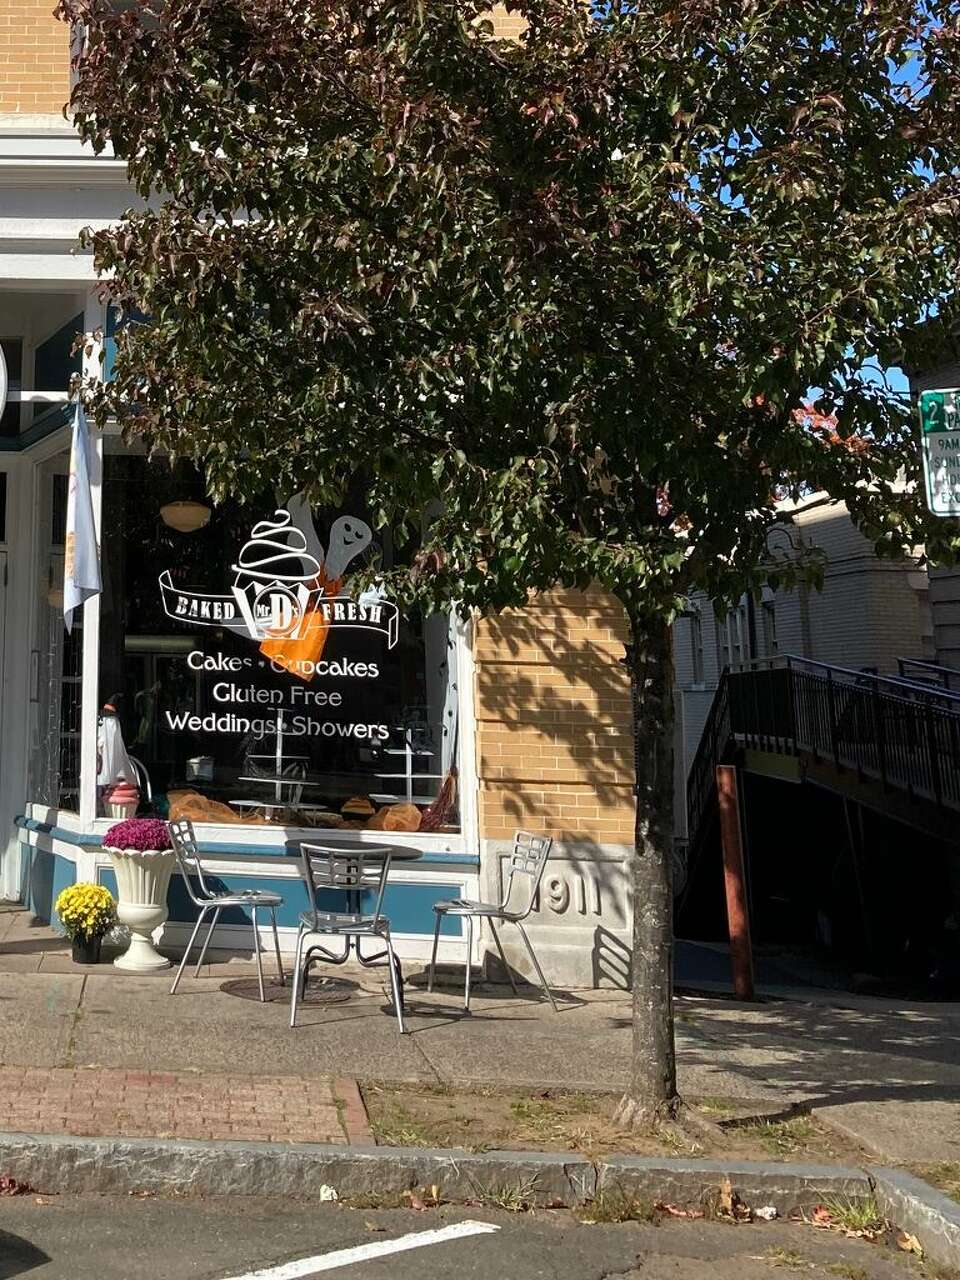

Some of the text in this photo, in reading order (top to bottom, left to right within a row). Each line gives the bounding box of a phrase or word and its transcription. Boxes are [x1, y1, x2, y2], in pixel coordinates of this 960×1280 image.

[928, 400, 939, 425] 2
[174, 596, 235, 620] BAKED
[256, 604, 272, 617] Mr.
[321, 603, 382, 624] FRESH
[187, 650, 380, 677] Cakes Cupcakes
[212, 682, 343, 706] Gluten Free
[165, 710, 390, 741] Weddings Showers
